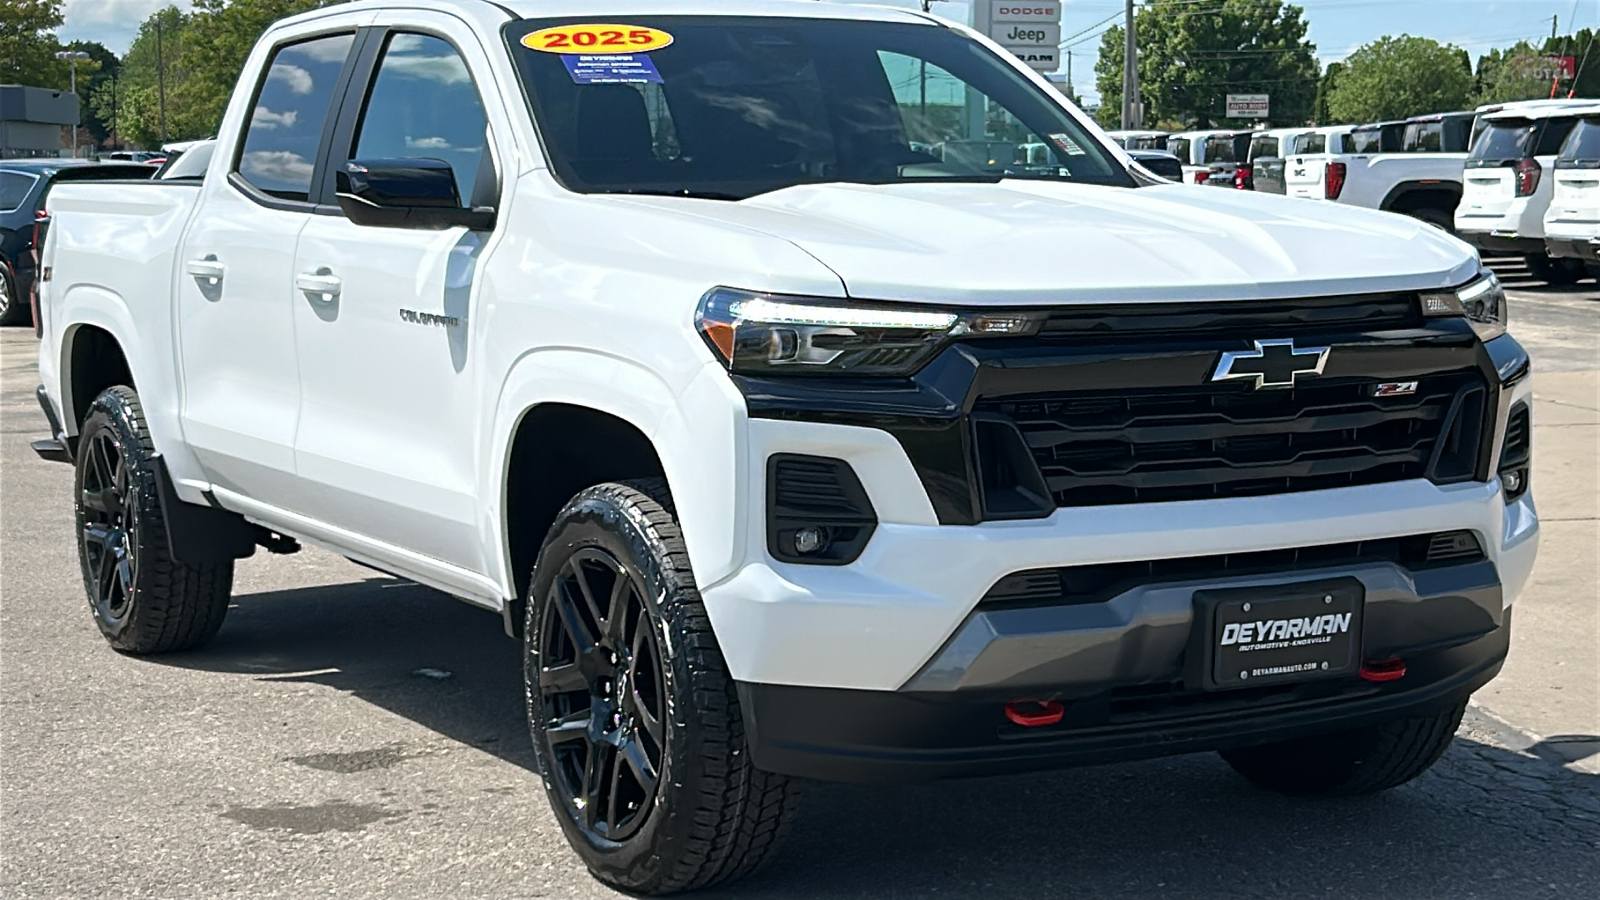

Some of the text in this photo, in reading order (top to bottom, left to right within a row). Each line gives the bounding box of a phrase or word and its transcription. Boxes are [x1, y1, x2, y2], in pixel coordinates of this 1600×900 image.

[999, 7, 1054, 15] DODGE
[543, 30, 653, 48] 2025
[1007, 26, 1046, 42] Jeep
[1373, 381, 1419, 397] Z71
[1221, 612, 1352, 645] DEYARMAN
[1252, 662, 1317, 677] DEYARMANAUTO.COM
